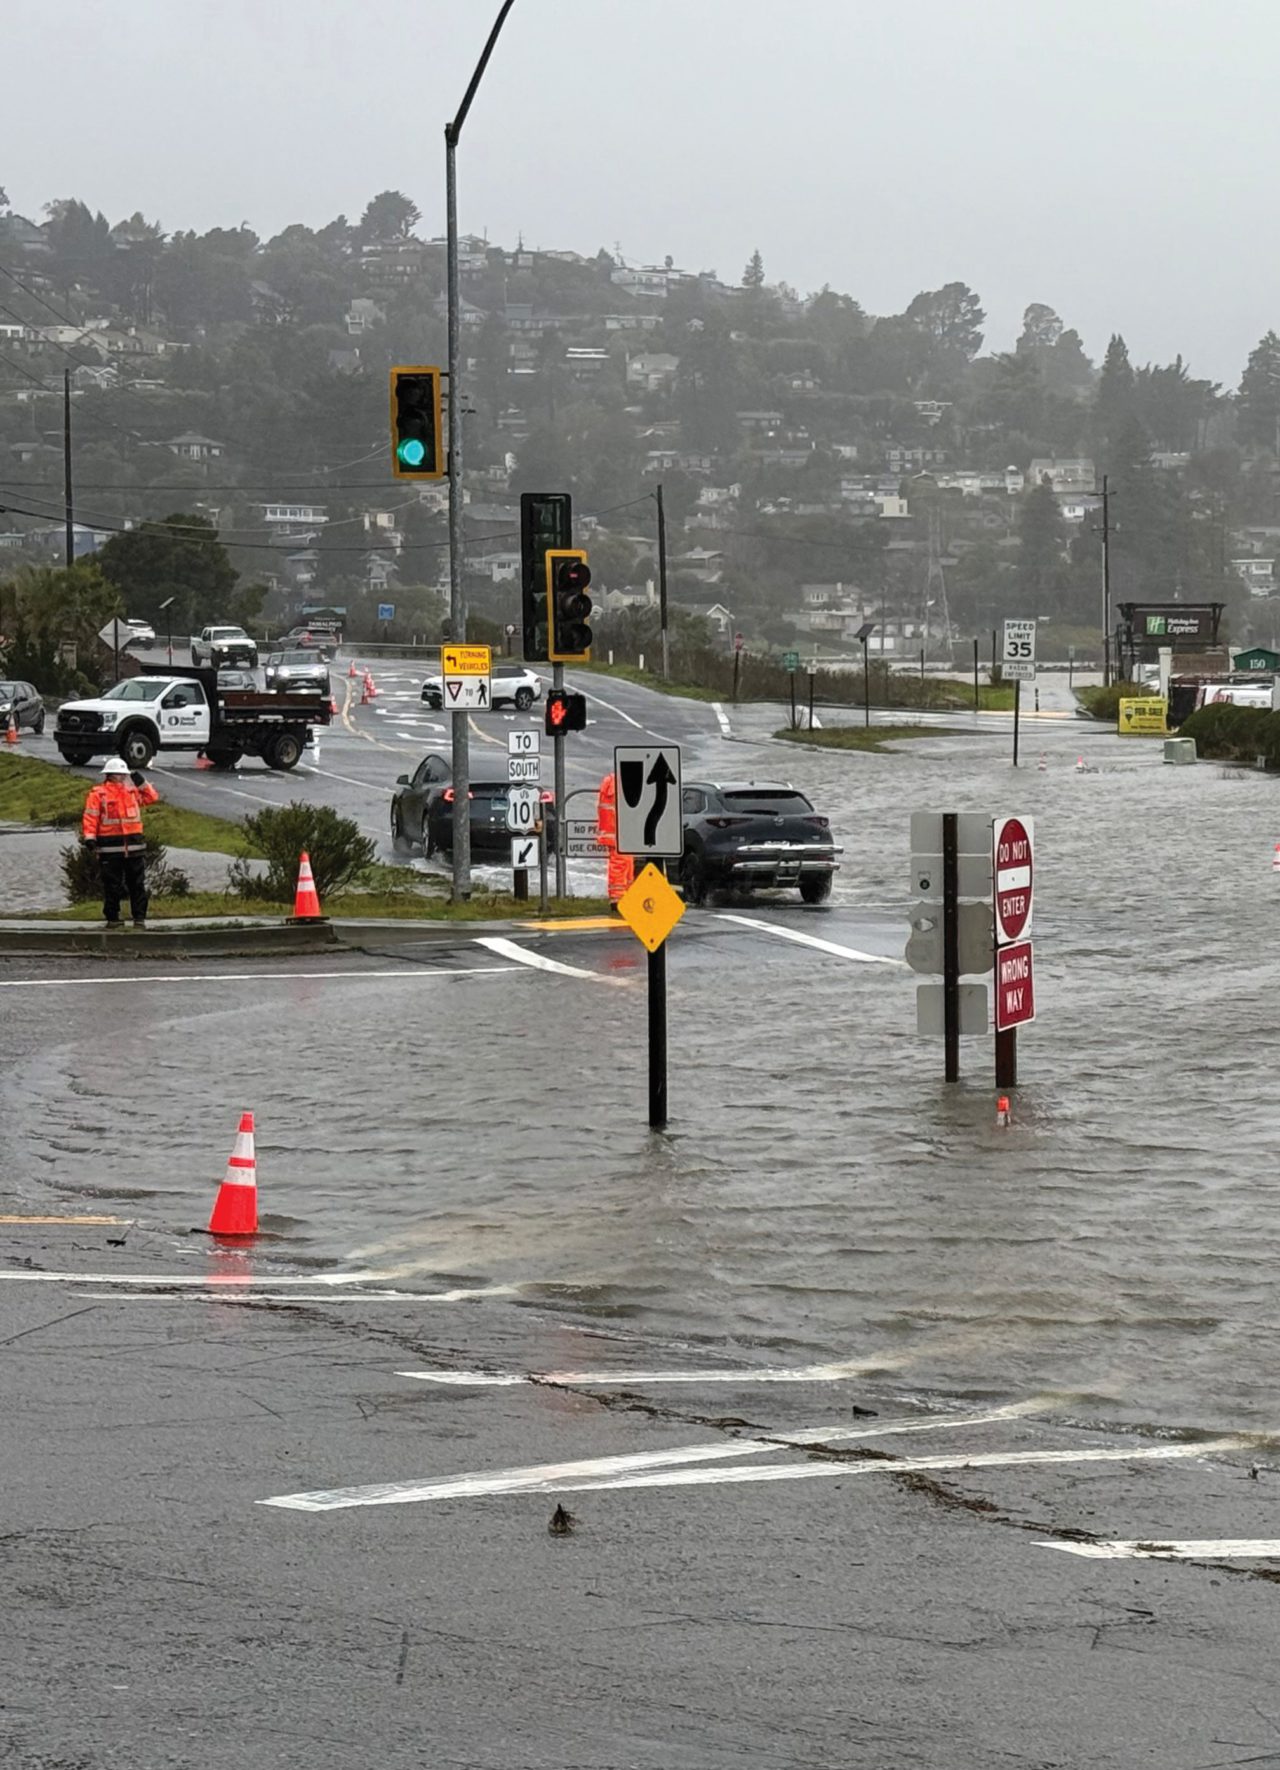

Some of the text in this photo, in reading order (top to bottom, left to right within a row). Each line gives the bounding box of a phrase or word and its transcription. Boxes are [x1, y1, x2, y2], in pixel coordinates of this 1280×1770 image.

[1006, 623, 1034, 631] SPEED
[1167, 625, 1199, 635] Express
[1008, 632, 1031, 640] LIMIT
[1007, 642, 1032, 657] 35
[1250, 659, 1266, 669] 150
[515, 735, 532, 749] TO
[509, 762, 538, 777] SOUTH
[520, 789, 530, 799] US
[512, 801, 535, 825] 10
[574, 825, 586, 834] NO
[570, 844, 584, 852] USE
[999, 840, 1028, 863] DO NOT
[1002, 895, 1025, 917] ENTER
[1001, 955, 1029, 984] WRONG
[1006, 988, 1024, 1014] WAY
